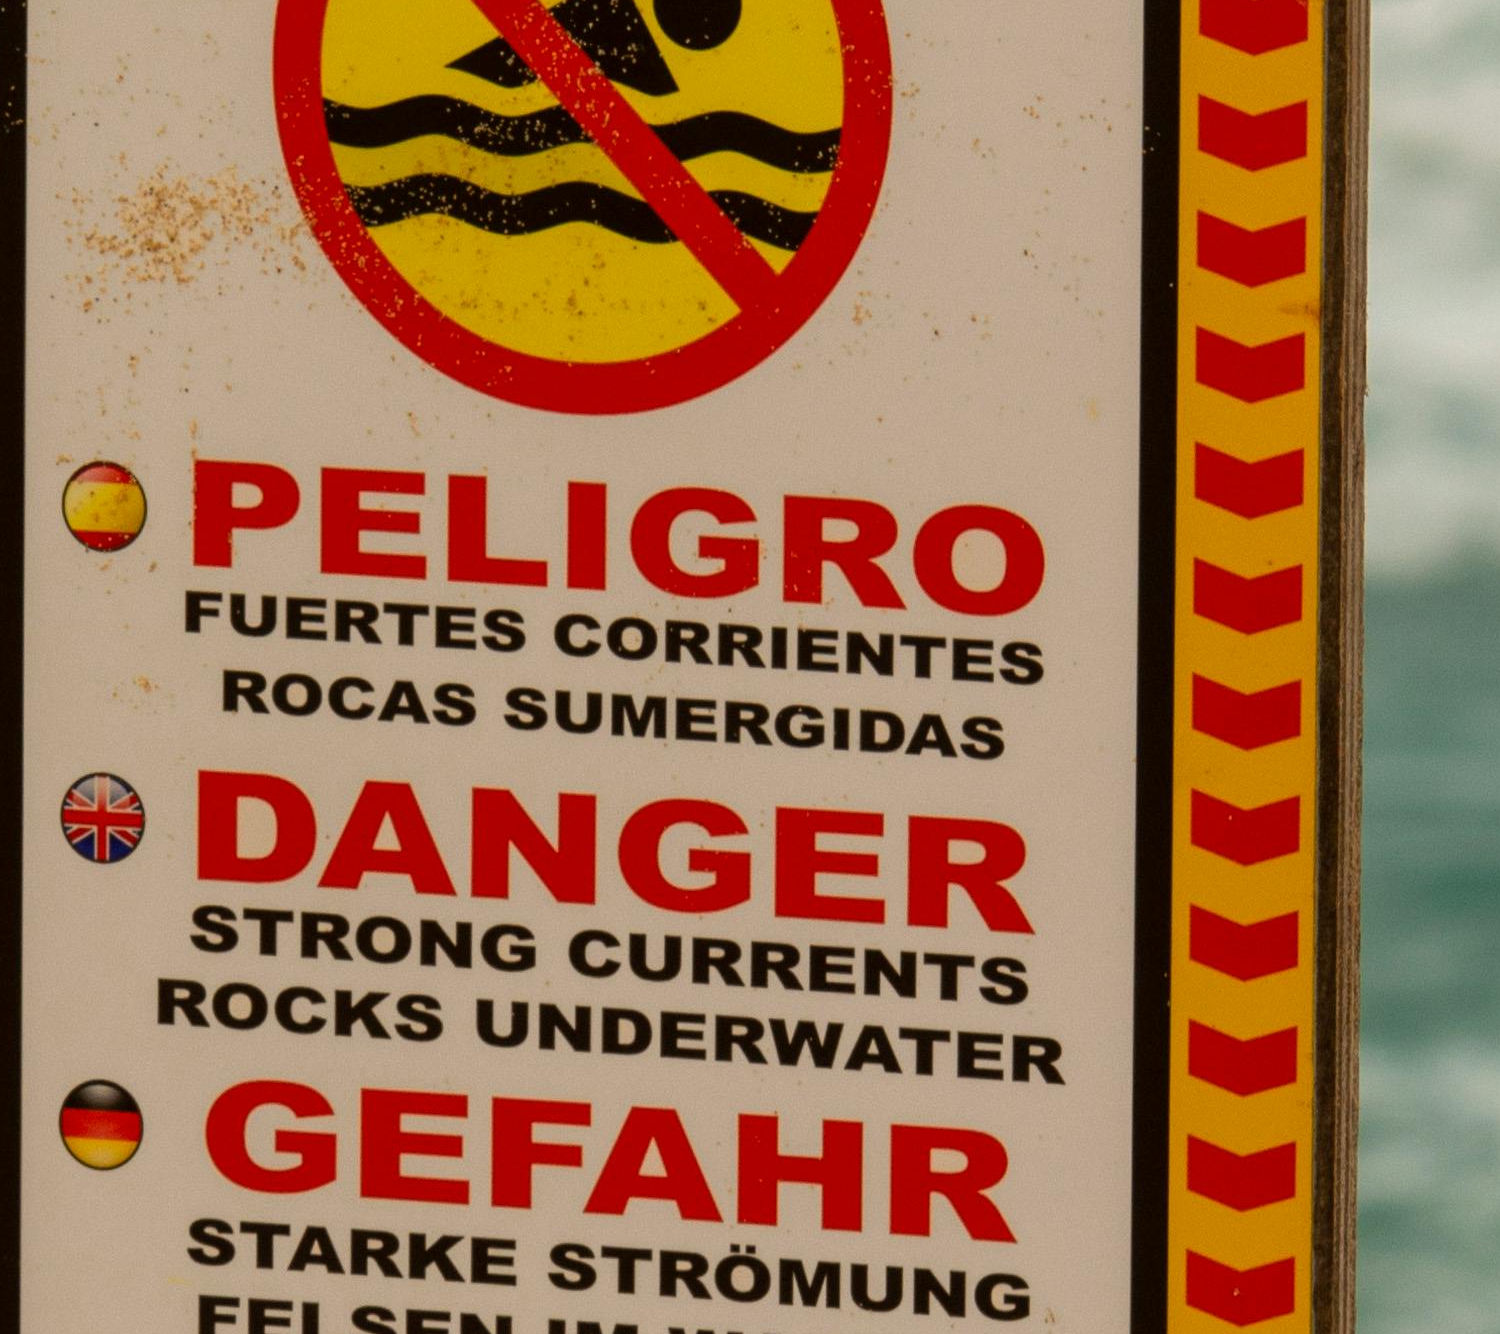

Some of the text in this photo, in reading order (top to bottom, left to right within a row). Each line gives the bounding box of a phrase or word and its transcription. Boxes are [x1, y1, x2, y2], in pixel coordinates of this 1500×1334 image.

[191, 458, 1046, 618] PELIGRO
[185, 590, 1044, 686] FUERTES CORRIENTES
[223, 670, 1005, 760] ROCAS SUMERGIDAS
[196, 768, 1035, 936] DANGER
[190, 905, 1029, 1006] STRONG CURRENTS
[157, 978, 1066, 1085] ROCKS UNDERWATER
[204, 1078, 1017, 1244] GEFAHR
[187, 1218, 1030, 1322] STARKE STRÖMUNG
